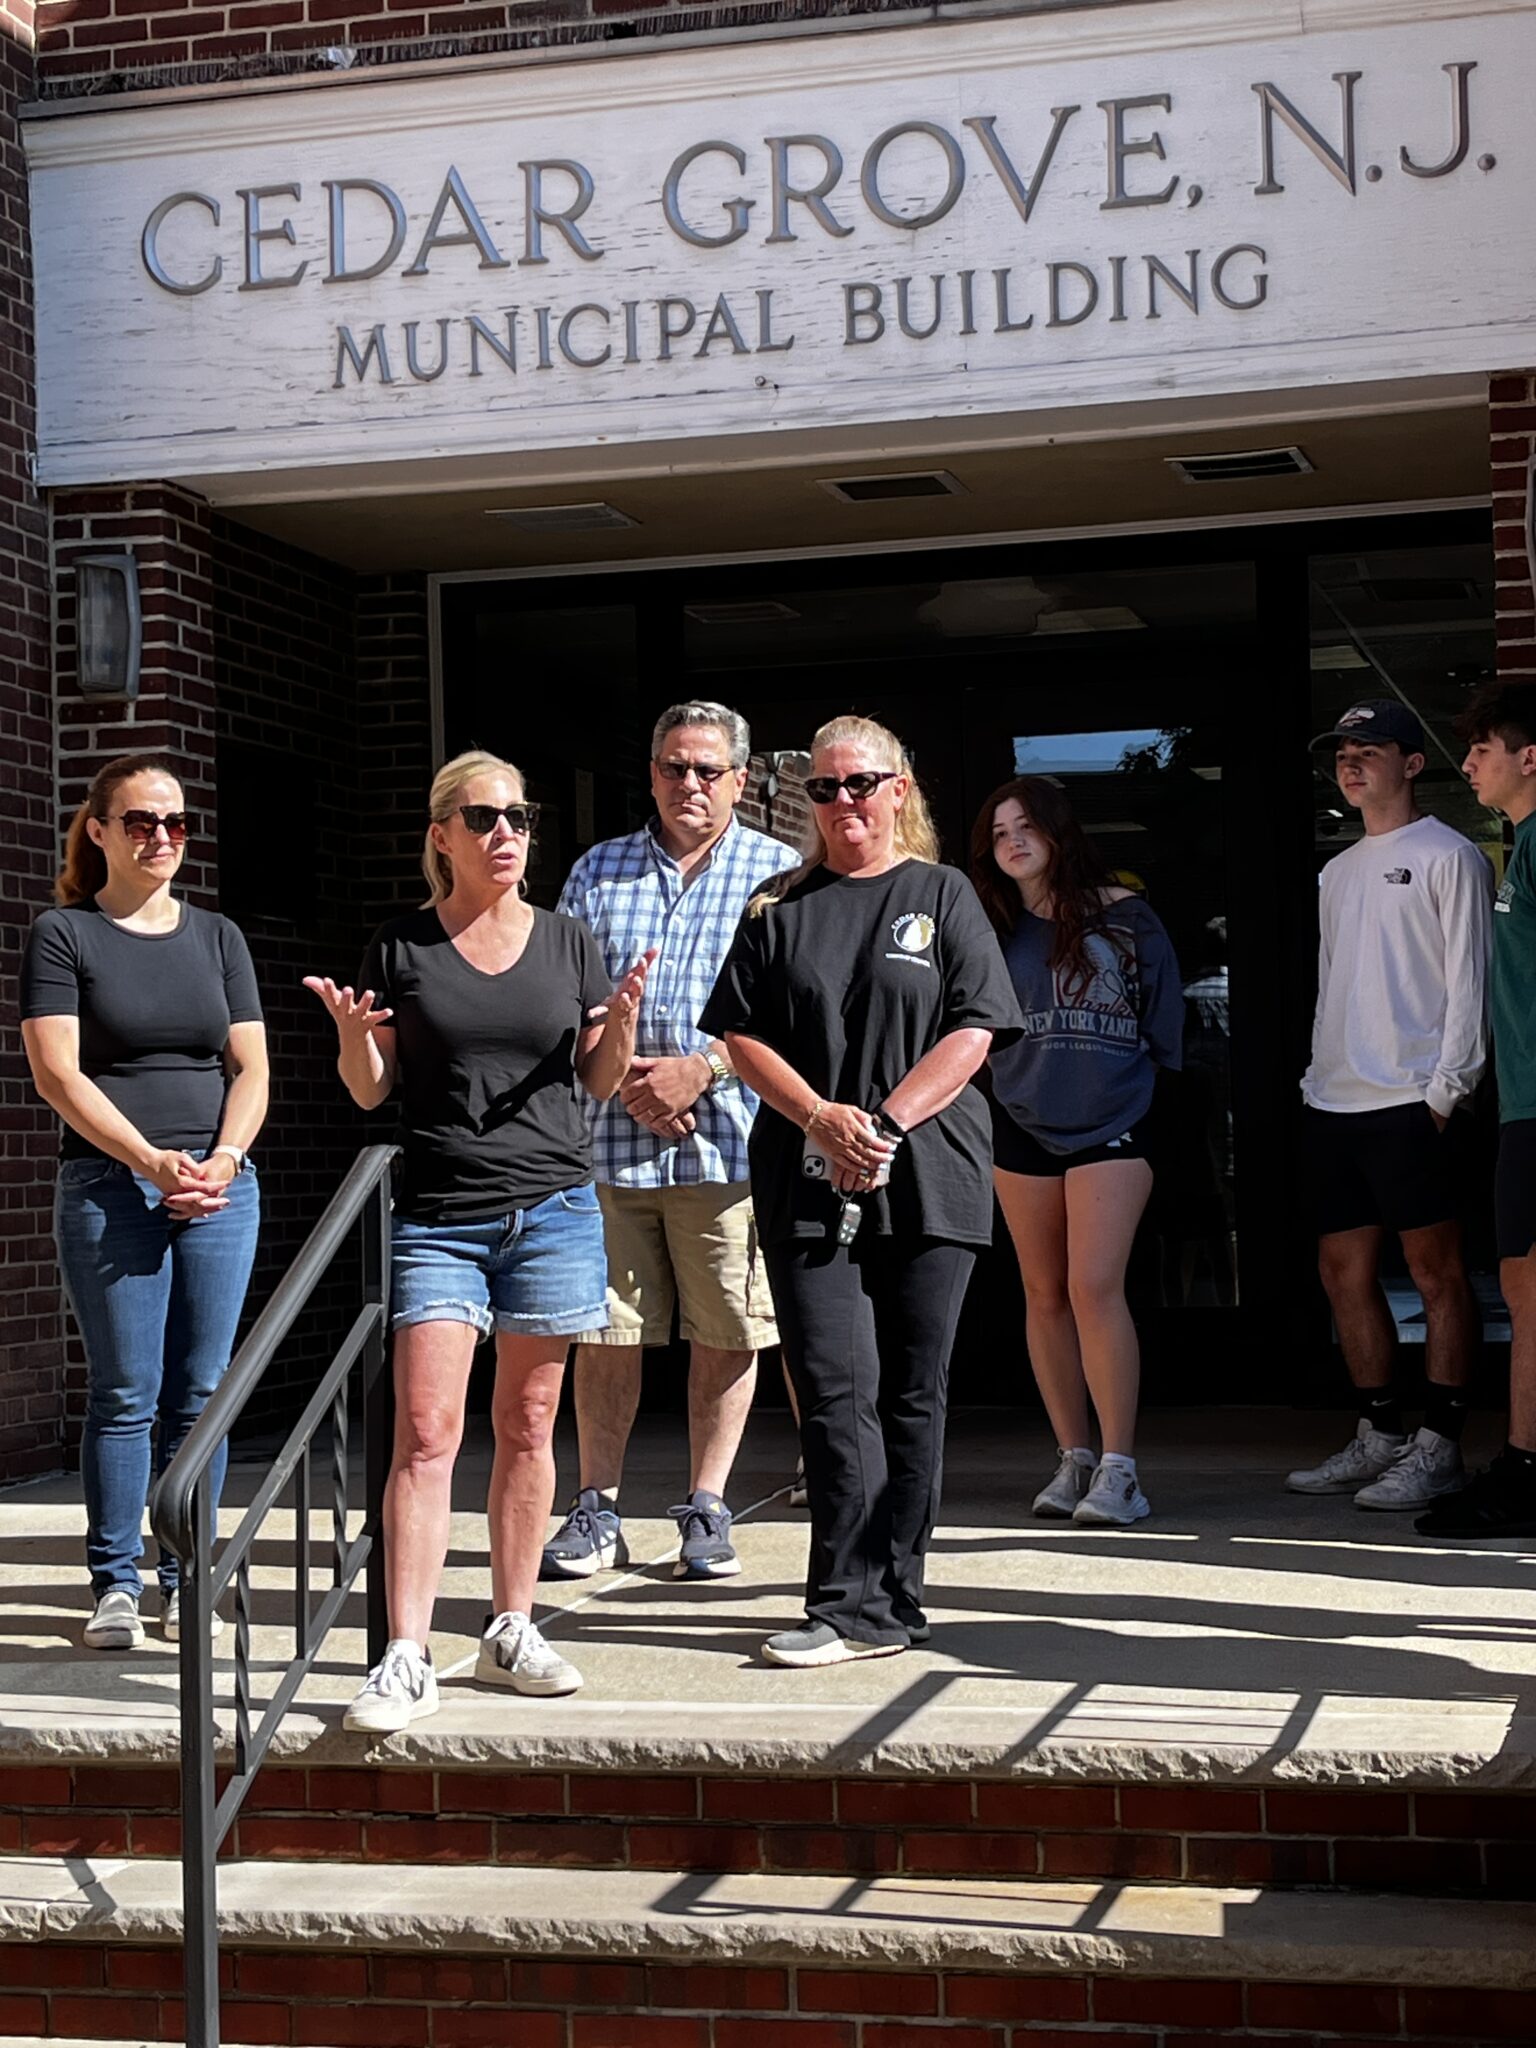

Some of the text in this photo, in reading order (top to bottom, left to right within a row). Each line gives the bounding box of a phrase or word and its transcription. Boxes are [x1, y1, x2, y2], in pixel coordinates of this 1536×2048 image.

[141, 61, 1497, 297] CEDAR GROVE, N.J.
[331, 243, 1269, 389] MUNICIPAL BUILDING
[1023, 1009, 1055, 1036] NEW
[1058, 1008, 1098, 1033] YORK
